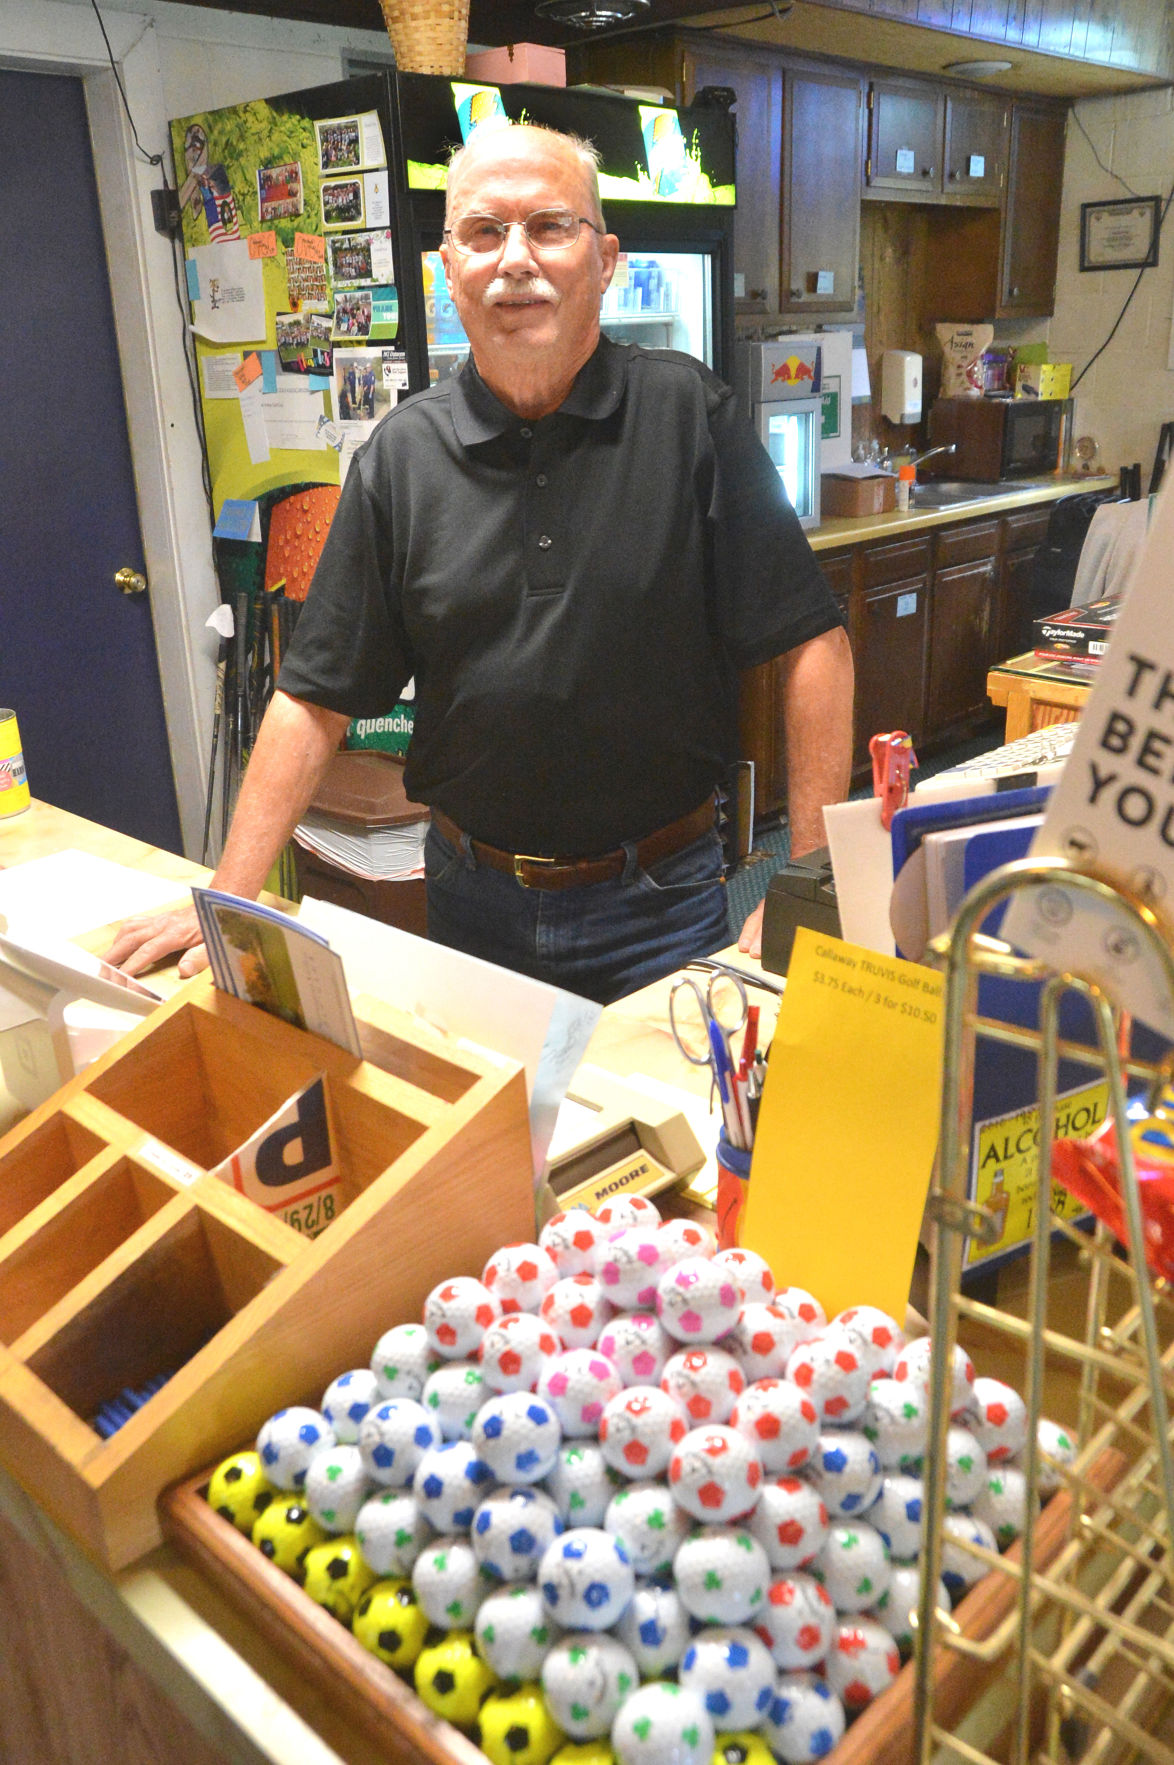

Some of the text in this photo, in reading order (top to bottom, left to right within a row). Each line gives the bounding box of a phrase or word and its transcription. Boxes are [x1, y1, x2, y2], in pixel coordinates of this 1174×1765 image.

[1042, 625, 1085, 639] TaylorMade
[1101, 709, 1174, 783] BE
[815, 944, 857, 969] Callaway
[860, 959, 896, 981] TRUVIS
[898, 973, 921, 990] Golf
[813, 970, 839, 989] $3.75
[841, 981, 865, 999] Each
[875, 993, 882, 1005] 3
[883, 996, 898, 1010] for
[900, 1001, 938, 1025] $10.50
[595, 1163, 650, 1201] MOORE
